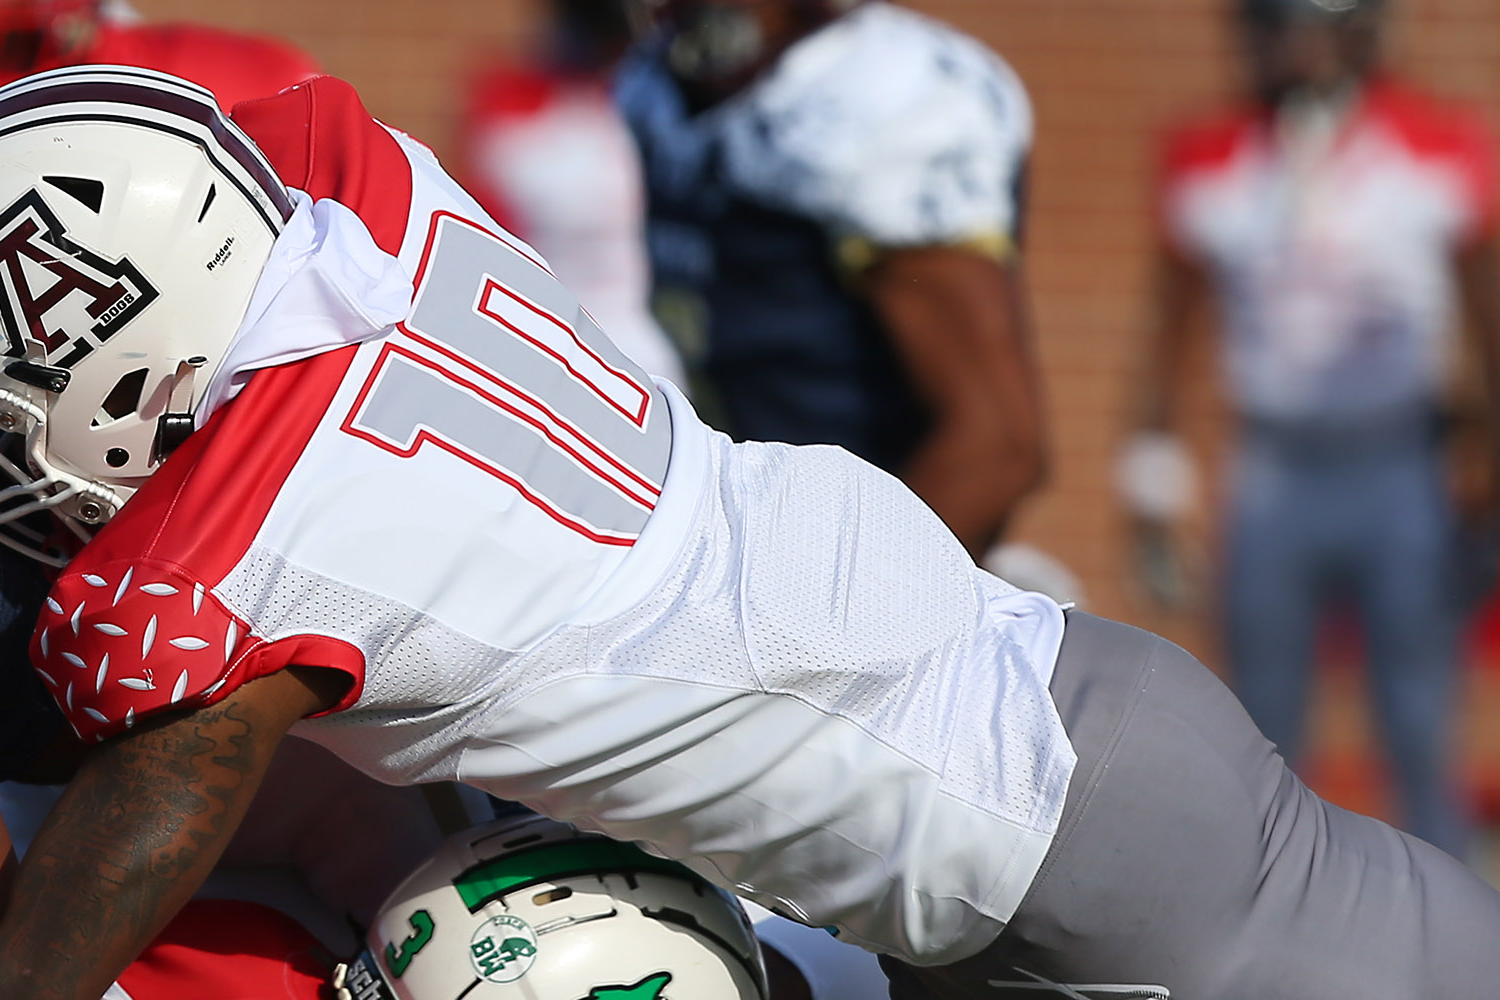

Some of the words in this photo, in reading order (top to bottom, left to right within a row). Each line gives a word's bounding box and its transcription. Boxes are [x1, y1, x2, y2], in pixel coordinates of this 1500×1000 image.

[206, 237, 234, 271] Riddell
[341, 210, 672, 546] 10
[385, 909, 435, 979] 3
